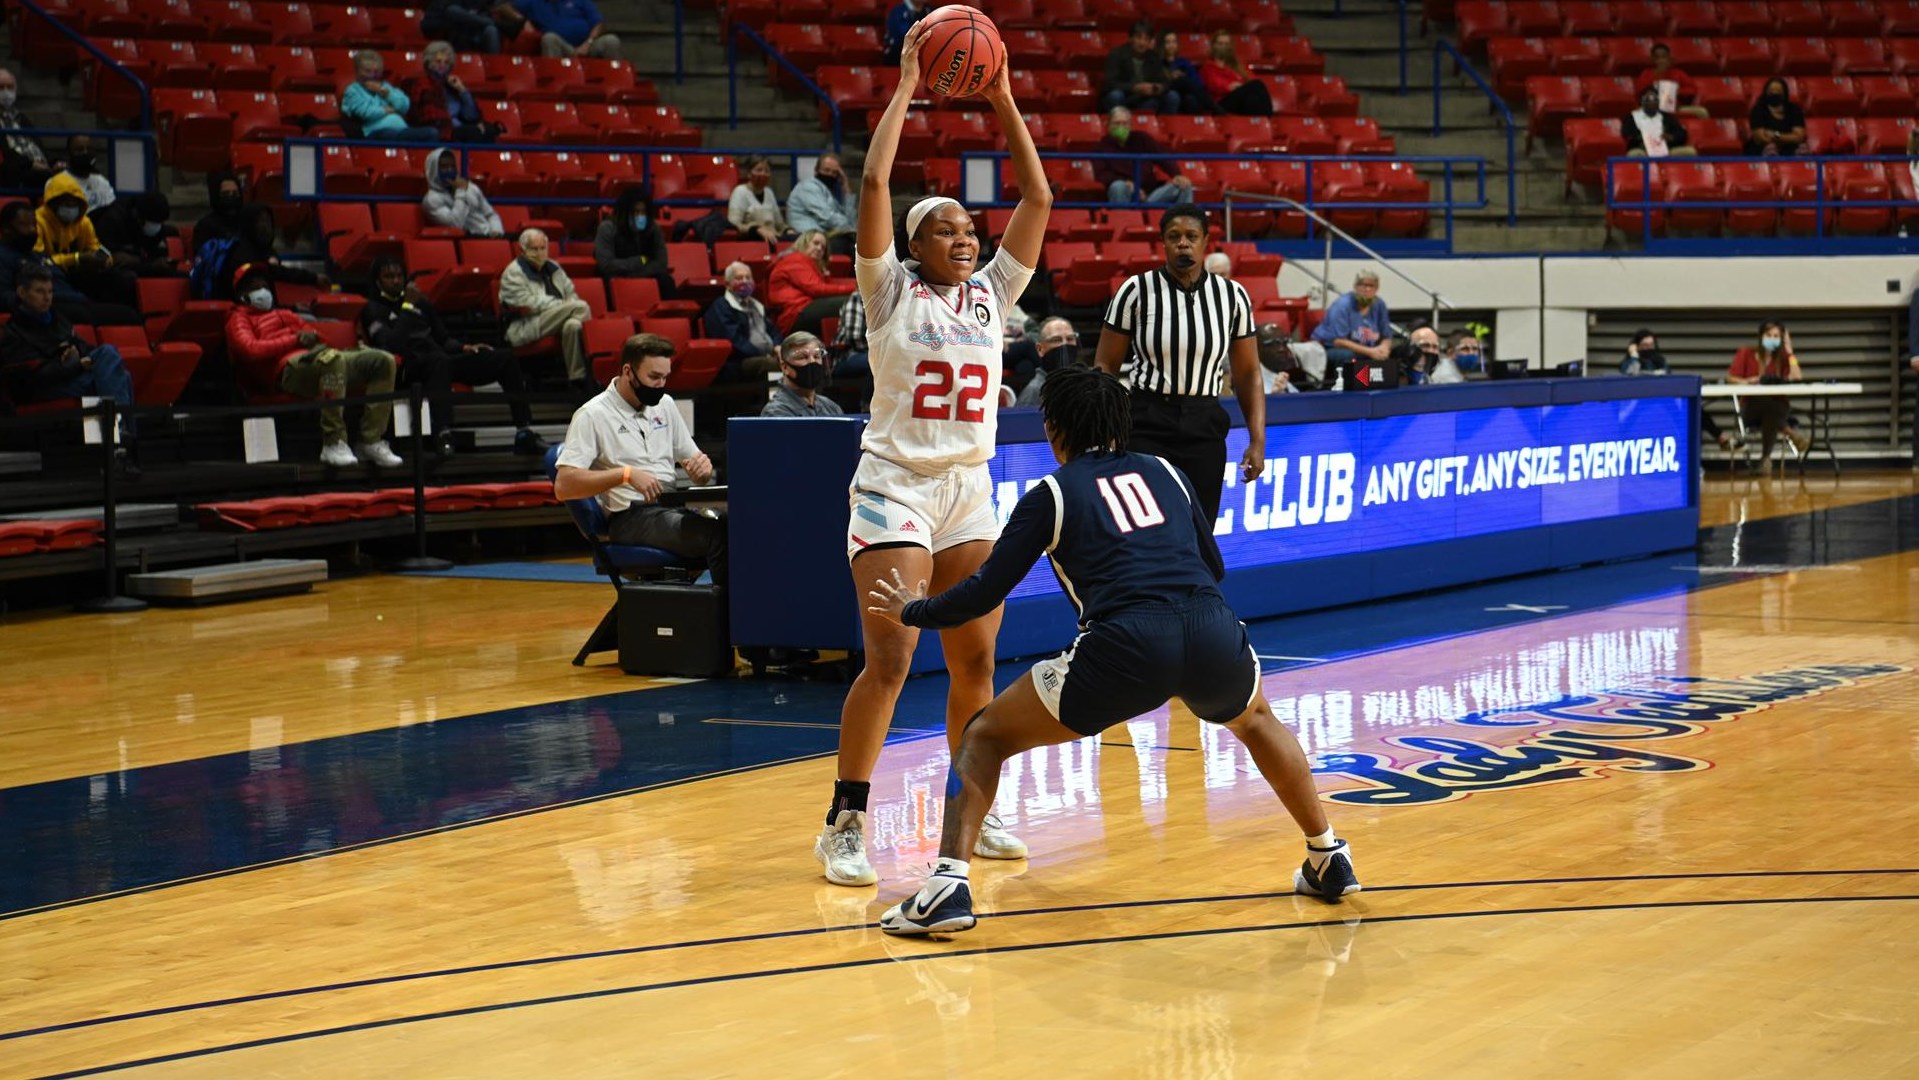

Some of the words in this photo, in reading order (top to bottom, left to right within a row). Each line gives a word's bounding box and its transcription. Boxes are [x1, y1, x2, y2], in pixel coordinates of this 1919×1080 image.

[933, 49, 967, 94] Wilson
[966, 64, 986, 93] CAA
[911, 359, 989, 423] 22
[1095, 472, 1166, 533] 10
[1243, 452, 1355, 532] CLUB
[1362, 460, 1416, 506] ANY
[1470, 449, 1518, 493] ANY
[1308, 735, 1708, 806] Lady
